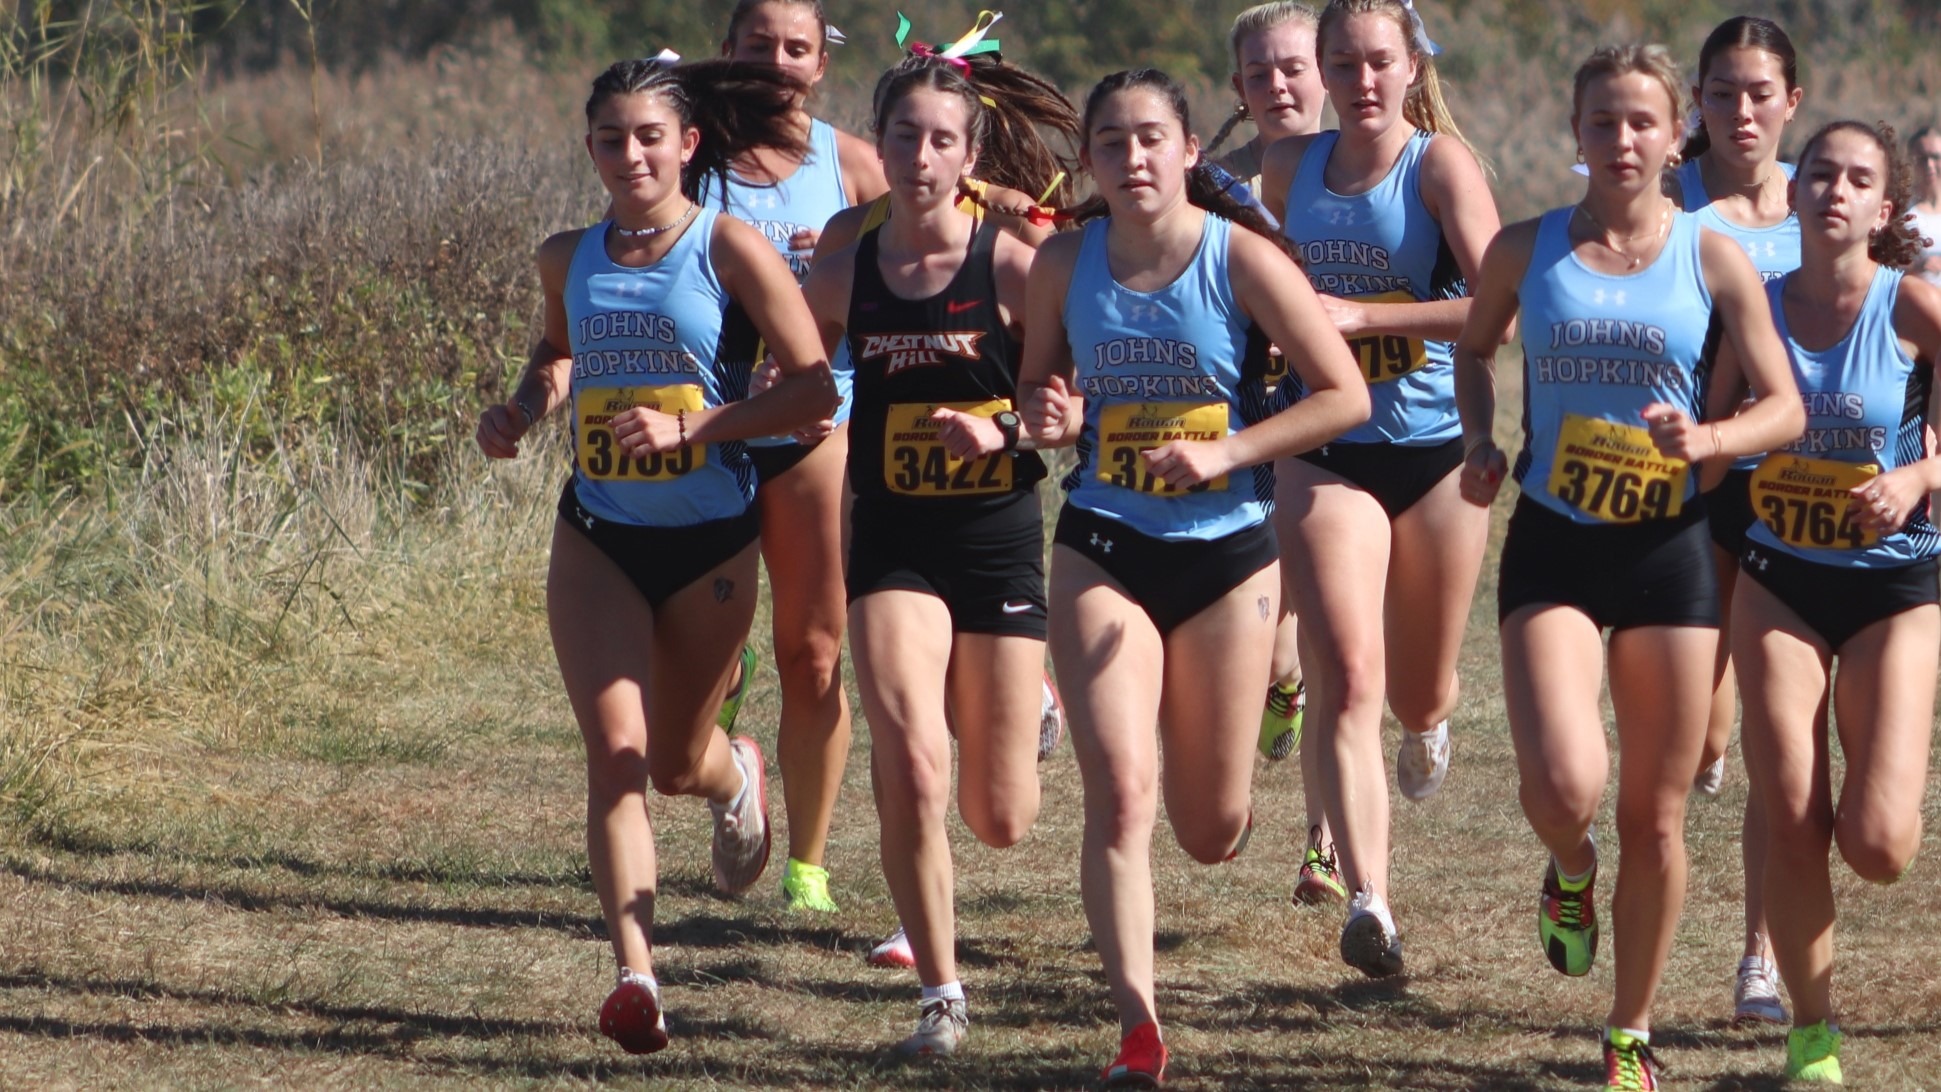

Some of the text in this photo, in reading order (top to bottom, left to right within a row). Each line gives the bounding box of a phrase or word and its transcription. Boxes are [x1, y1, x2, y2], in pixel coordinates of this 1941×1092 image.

[1306, 273, 1414, 295] OPKINS
[579, 311, 676, 345] JOHNS
[1552, 318, 1666, 355] JOHNS
[862, 333, 983, 359] CHESTNUT
[1095, 337, 1197, 369] JOHNS
[1345, 334, 1412, 376] 79
[573, 349, 700, 381] HOPKINS
[1536, 355, 1685, 390] HOPKINS
[1083, 374, 1220, 398] HOPKINS
[585, 415, 615, 425] BOR
[1799, 391, 1864, 420] HNS
[893, 432, 939, 441] BORDE
[1107, 431, 1219, 442] BORDER BATTLE
[1780, 425, 1887, 453] PKINS
[894, 446, 1002, 491] 3422
[1564, 443, 1680, 477] BORDER BATTLE
[1558, 460, 1672, 519] 3769
[1758, 480, 1858, 500] BORDER BATT
[1762, 495, 1864, 547] 3764
